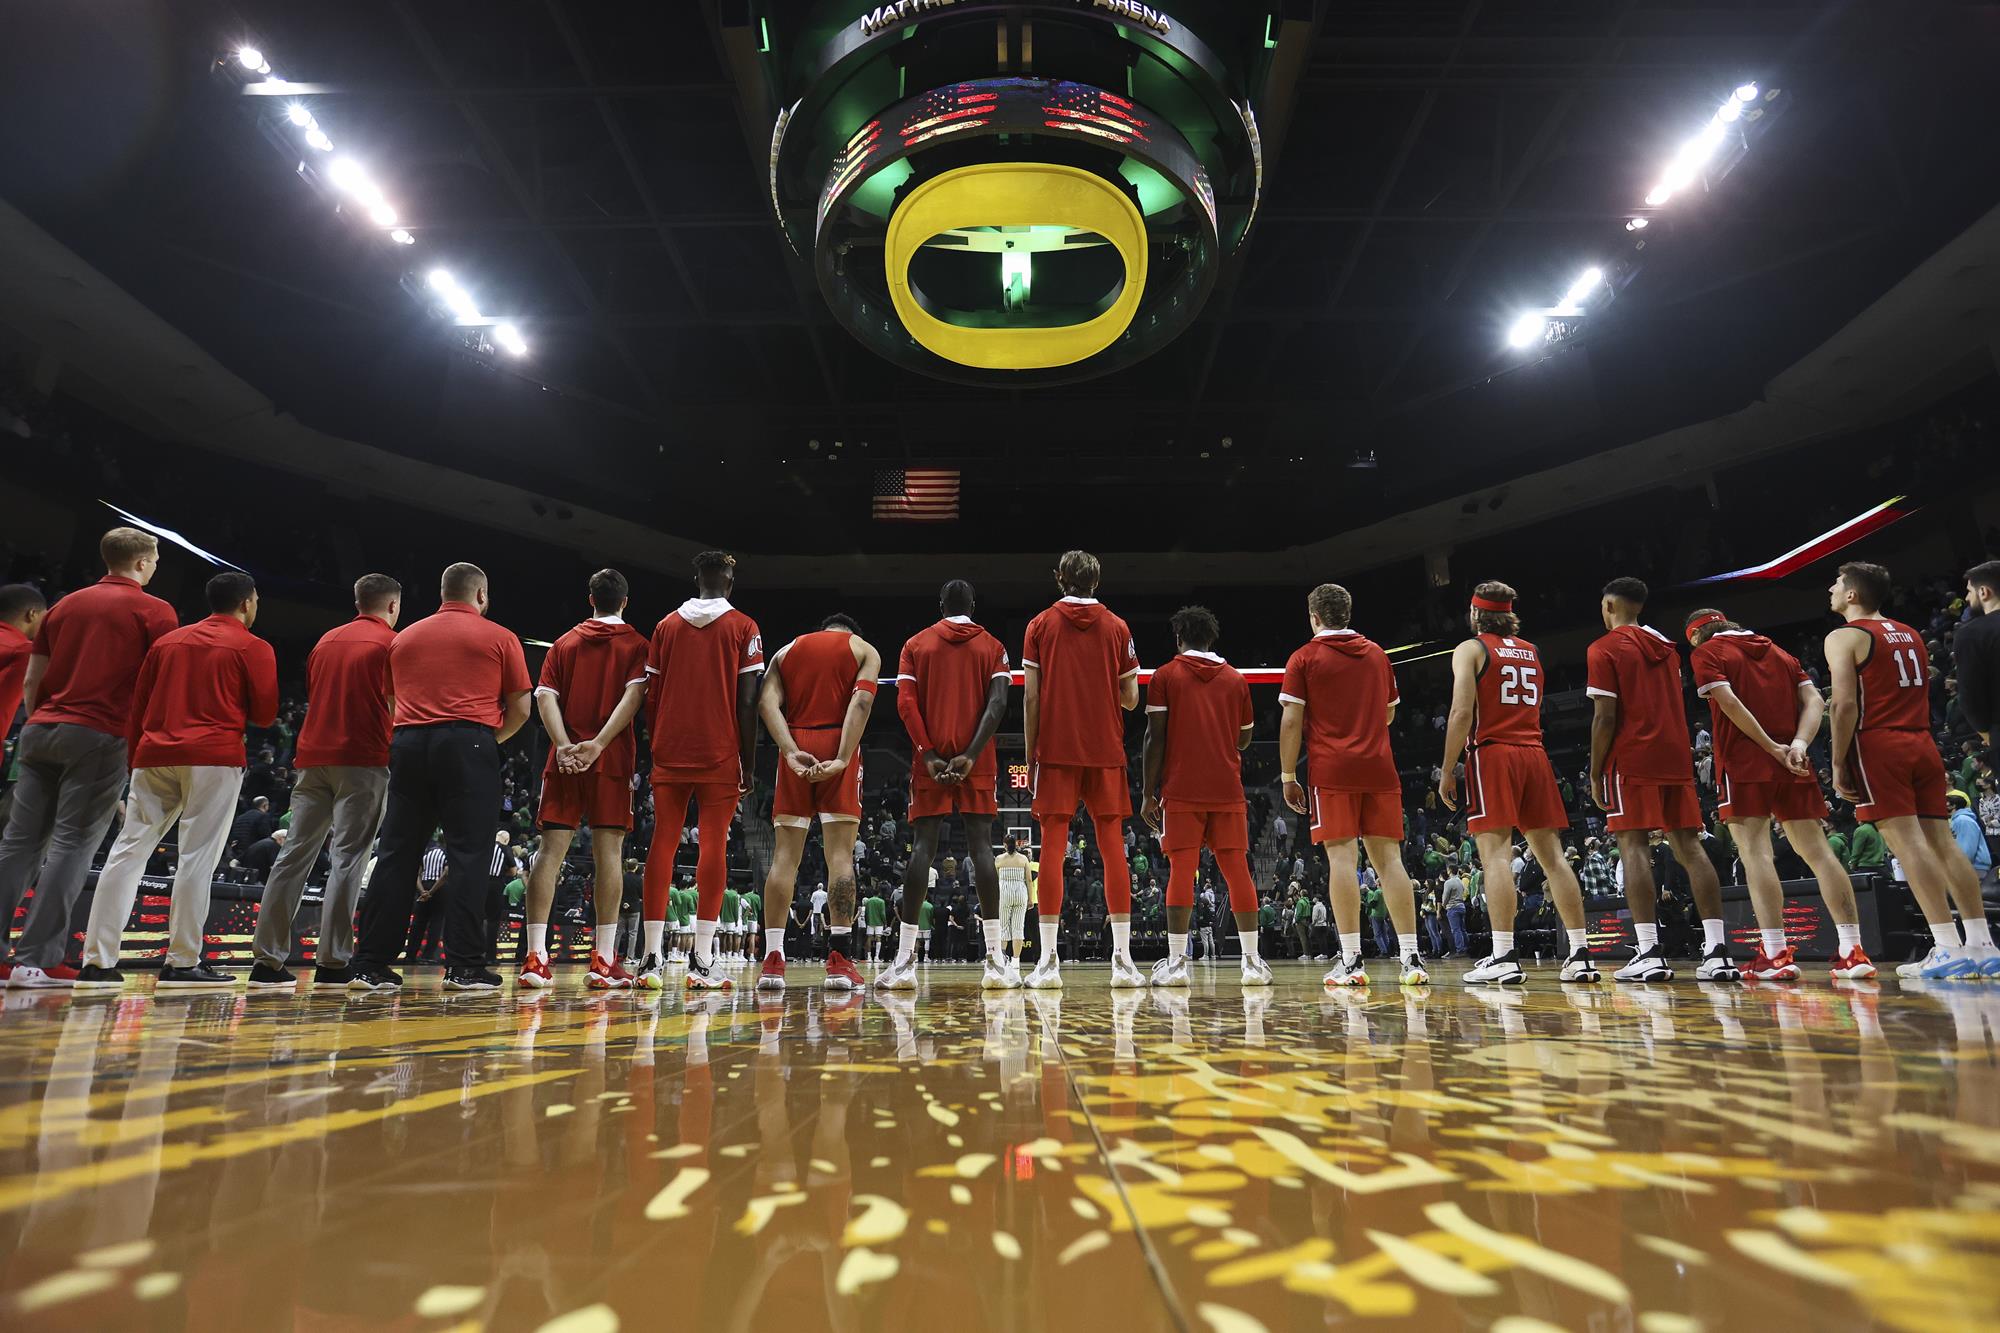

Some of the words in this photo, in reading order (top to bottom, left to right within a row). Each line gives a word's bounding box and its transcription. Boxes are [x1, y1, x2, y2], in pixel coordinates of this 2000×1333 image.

[1495, 647, 1535, 661] WORSTER
[1894, 649, 1923, 687] 11
[1501, 665, 1538, 706] 25
[1011, 774, 1028, 788] 30
[142, 881, 168, 889] Mortgage
